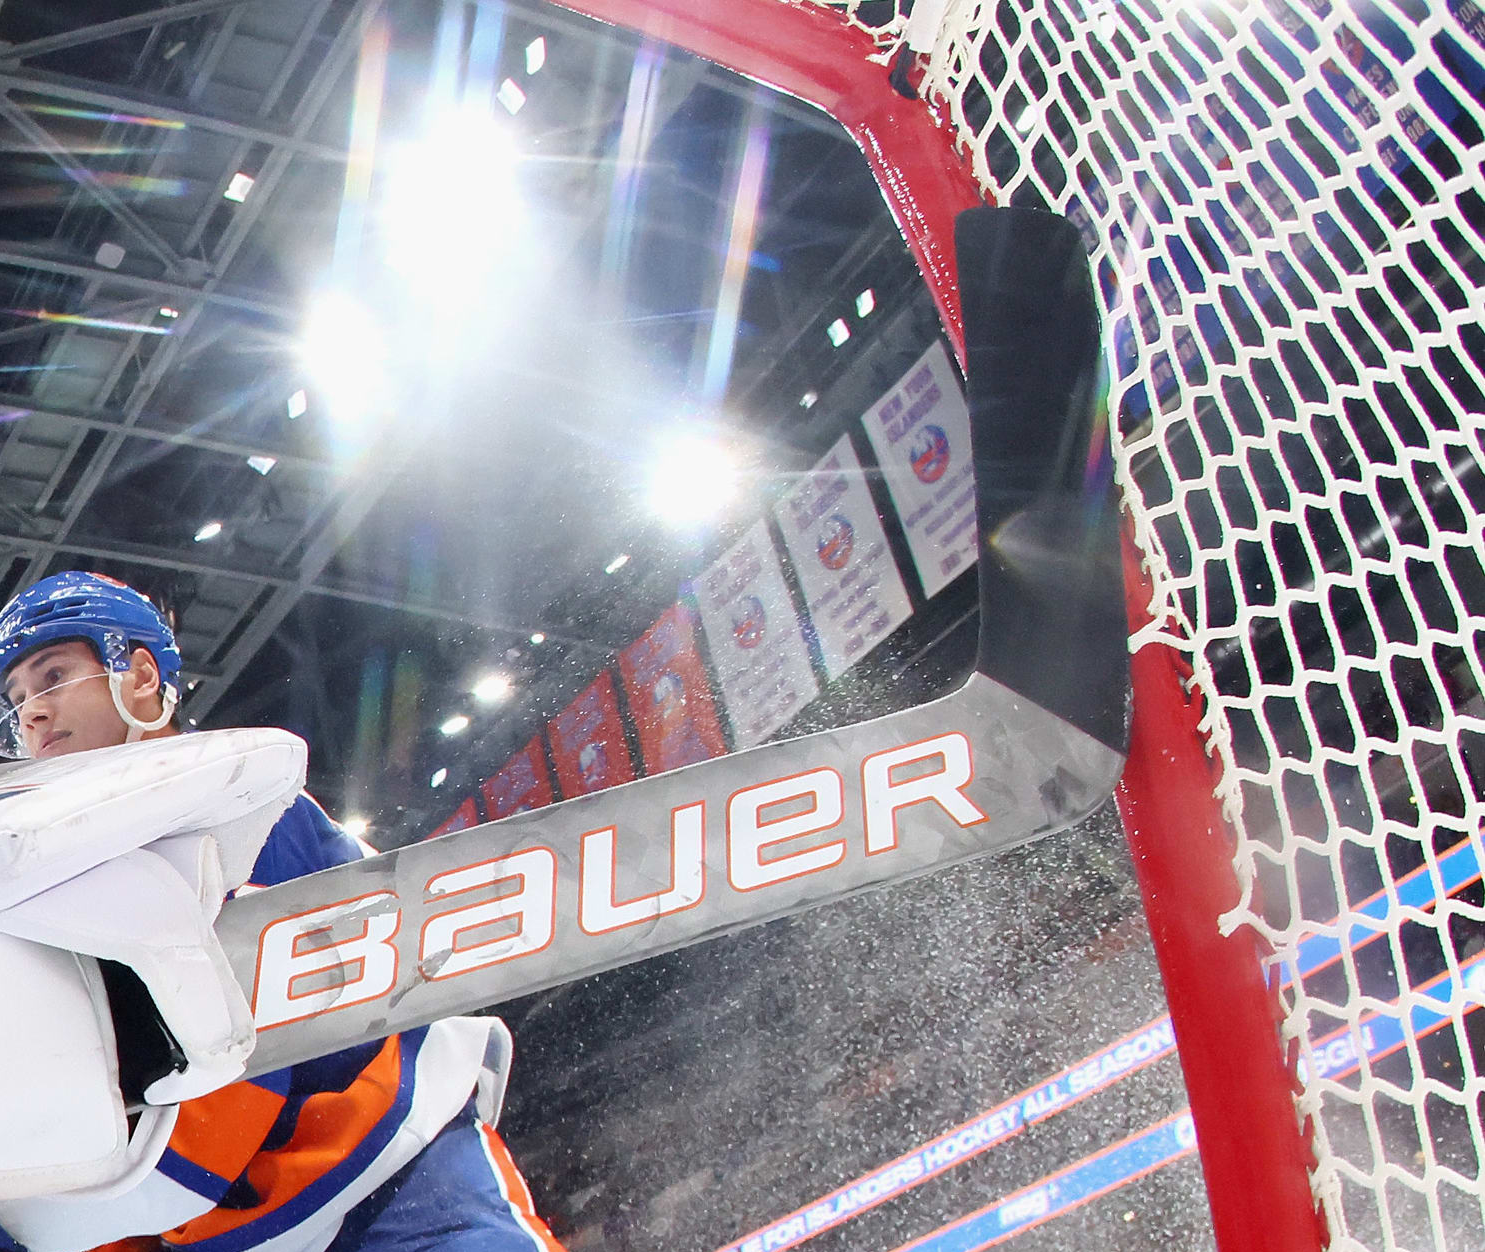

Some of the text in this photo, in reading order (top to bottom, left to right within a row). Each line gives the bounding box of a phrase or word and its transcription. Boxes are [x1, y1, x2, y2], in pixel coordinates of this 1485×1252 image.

[762, 1215, 806, 1252] FOR
[805, 1155, 926, 1235] ISLANDERS
[924, 1105, 1022, 1170] HOCKEY
[1022, 1082, 1071, 1121] ALL
[1068, 1021, 1174, 1095] SEASON
